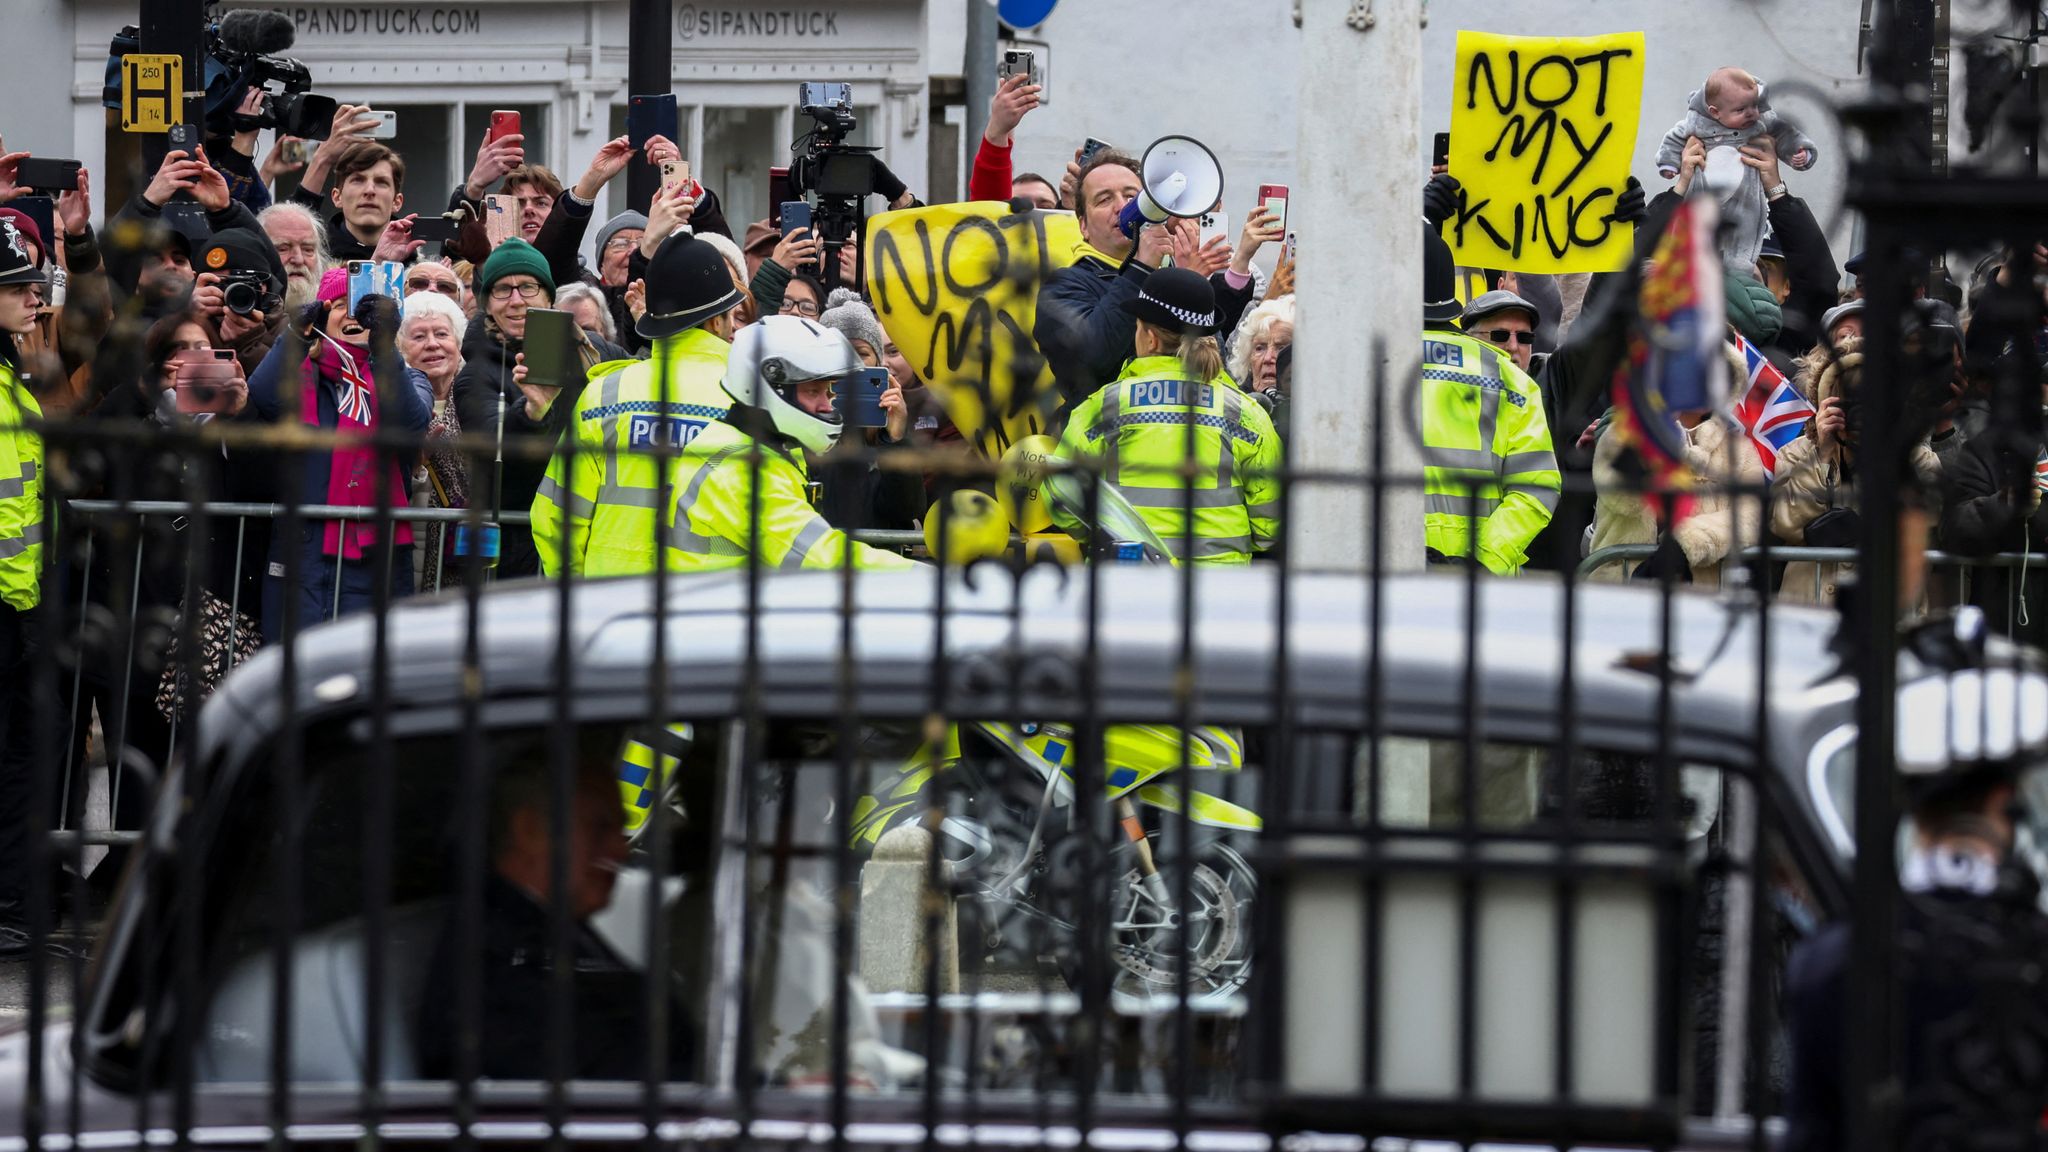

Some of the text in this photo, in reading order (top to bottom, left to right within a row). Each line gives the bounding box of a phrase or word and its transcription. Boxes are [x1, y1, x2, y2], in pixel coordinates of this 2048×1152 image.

[215, 8, 480, 34] PANDTUCK.COM
[677, 3, 839, 41] @SIPANDTUCK
[142, 67, 160, 78] 250
[1467, 49, 1632, 116] NOT
[149, 108, 160, 120] 14
[1484, 109, 1613, 199] MY
[1454, 187, 1616, 260] KING
[873, 212, 1066, 316] NOT
[1425, 341, 1460, 366] ICE
[1134, 381, 1210, 406] POLICE
[632, 419, 703, 449] POLIC
